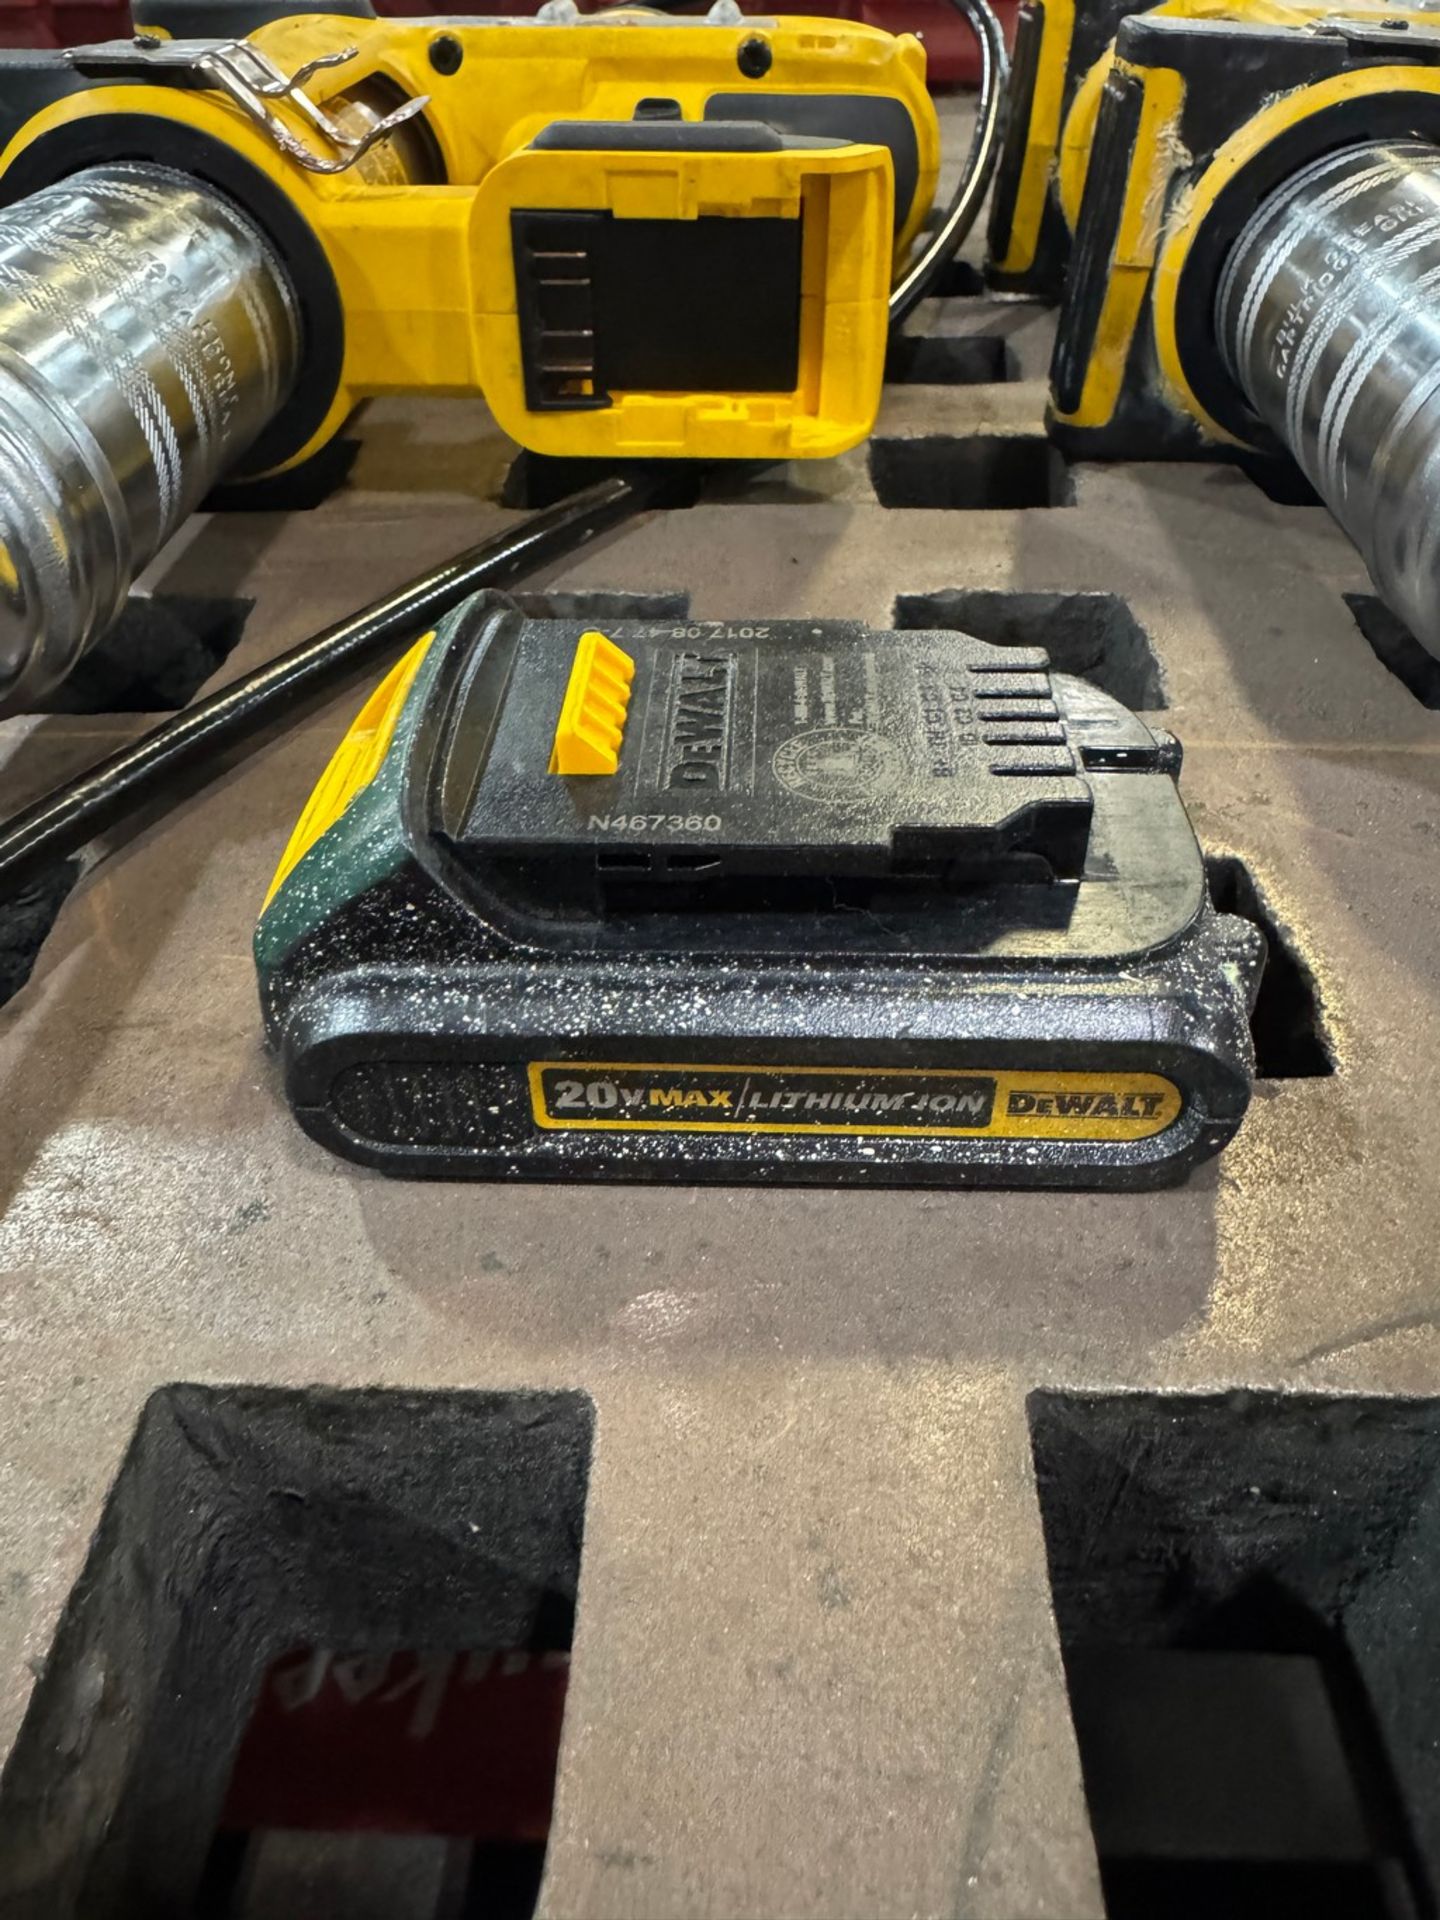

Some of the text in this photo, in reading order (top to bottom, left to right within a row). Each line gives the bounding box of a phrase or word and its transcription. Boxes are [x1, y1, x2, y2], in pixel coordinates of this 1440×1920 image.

[705, 627, 771, 640] 2017
[586, 814, 722, 831] N467360
[649, 1088, 734, 1108] MAX
[749, 1090, 905, 1111] LITHIUM
